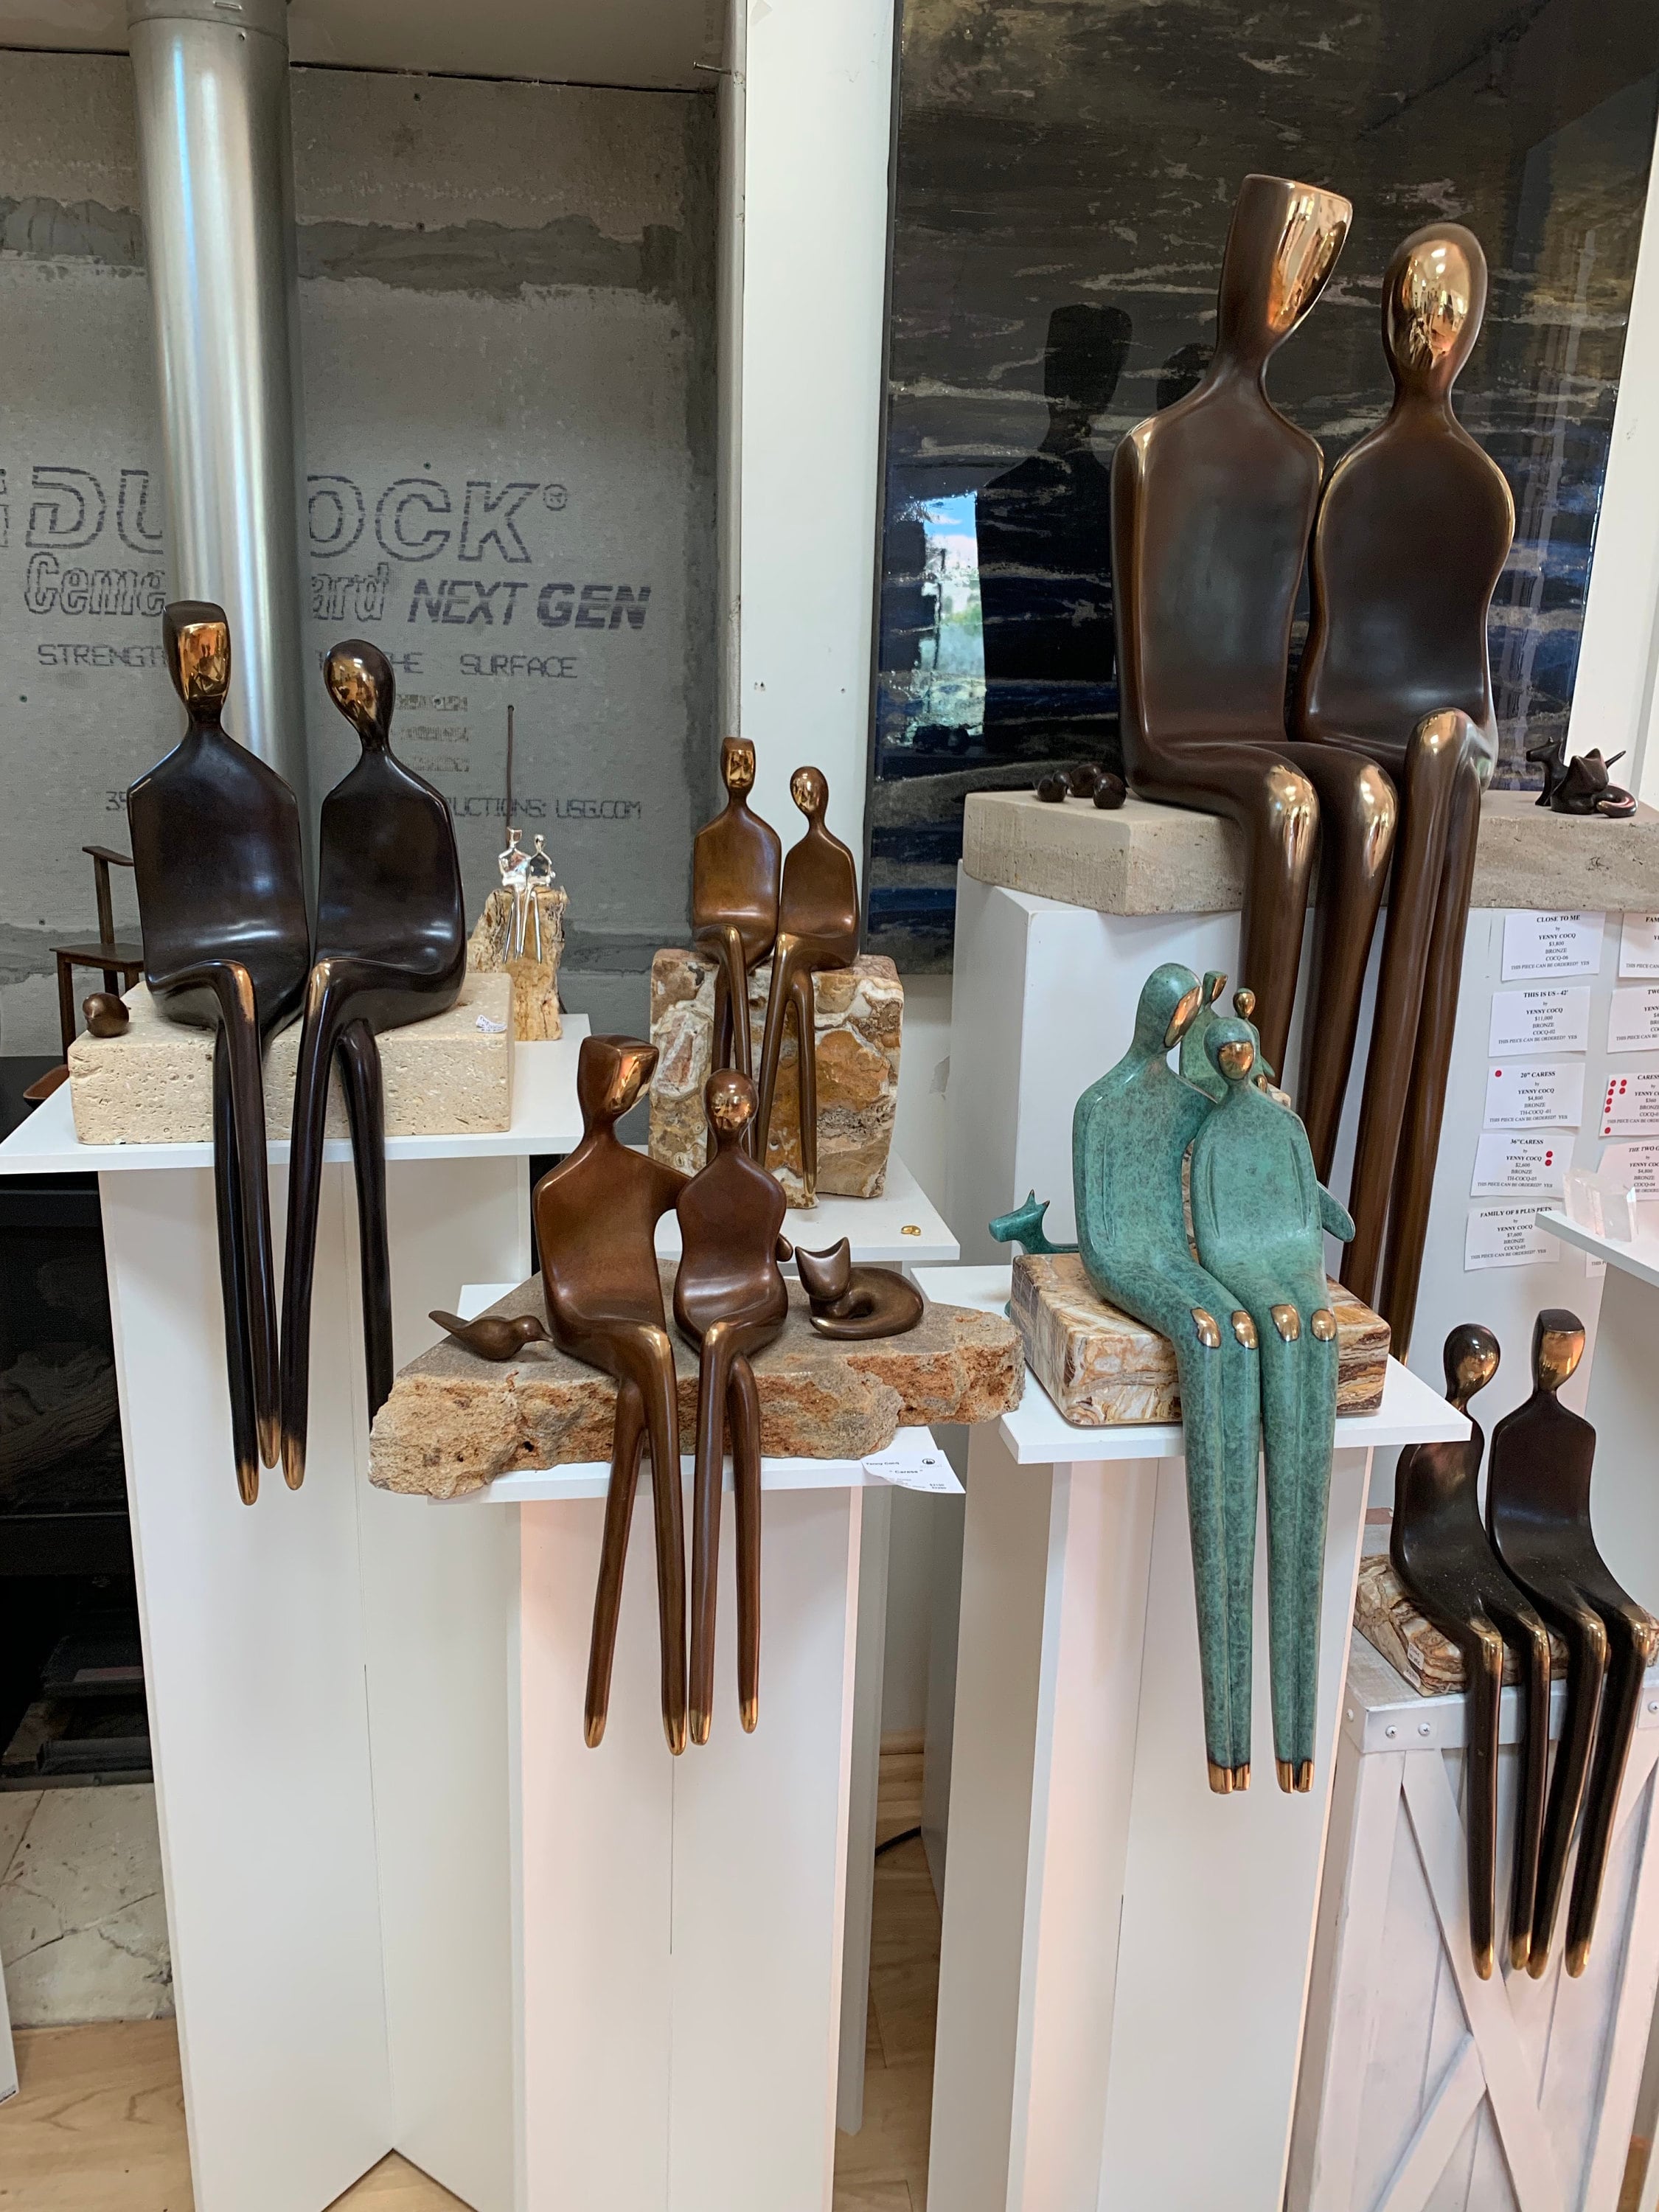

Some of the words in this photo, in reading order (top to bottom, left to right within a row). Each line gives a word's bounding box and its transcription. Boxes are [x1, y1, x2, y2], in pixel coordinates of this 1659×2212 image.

[407, 578, 529, 625] NEXT
[537, 582, 652, 630] GEN
[460, 653, 578, 679] SURFACE
[556, 799, 641, 819] USG.COM
